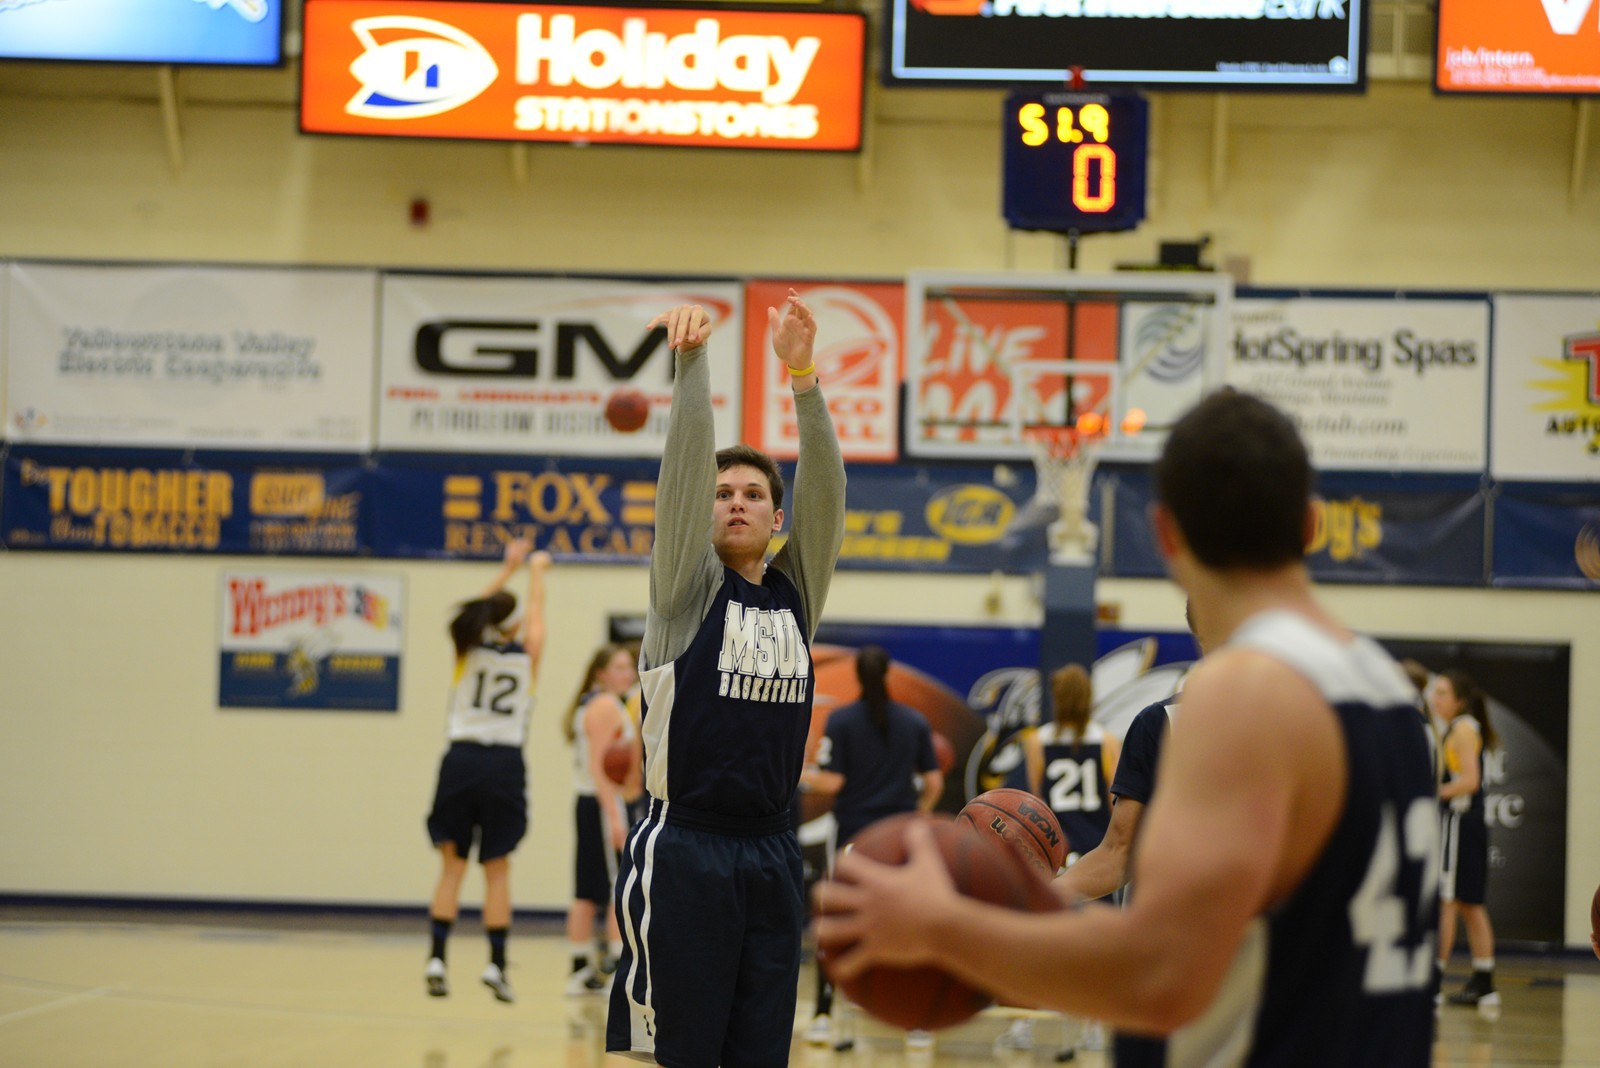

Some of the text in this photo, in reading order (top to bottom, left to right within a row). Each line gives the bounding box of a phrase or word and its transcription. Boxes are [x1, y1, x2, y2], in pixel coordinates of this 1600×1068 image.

[515, 13, 820, 103] Holiday
[1072, 143, 1116, 212] 0
[413, 318, 681, 382] GM
[1393, 327, 1477, 376] Spas
[778, 396, 883, 415] TCO
[780, 421, 882, 442] BLL
[49, 466, 234, 518] TOUGHER
[493, 470, 613, 524] FOX
[229, 578, 347, 636] Wendy's
[472, 670, 520, 715] 12
[1047, 757, 1103, 813] 21
[1018, 802, 1059, 848] NCAA
